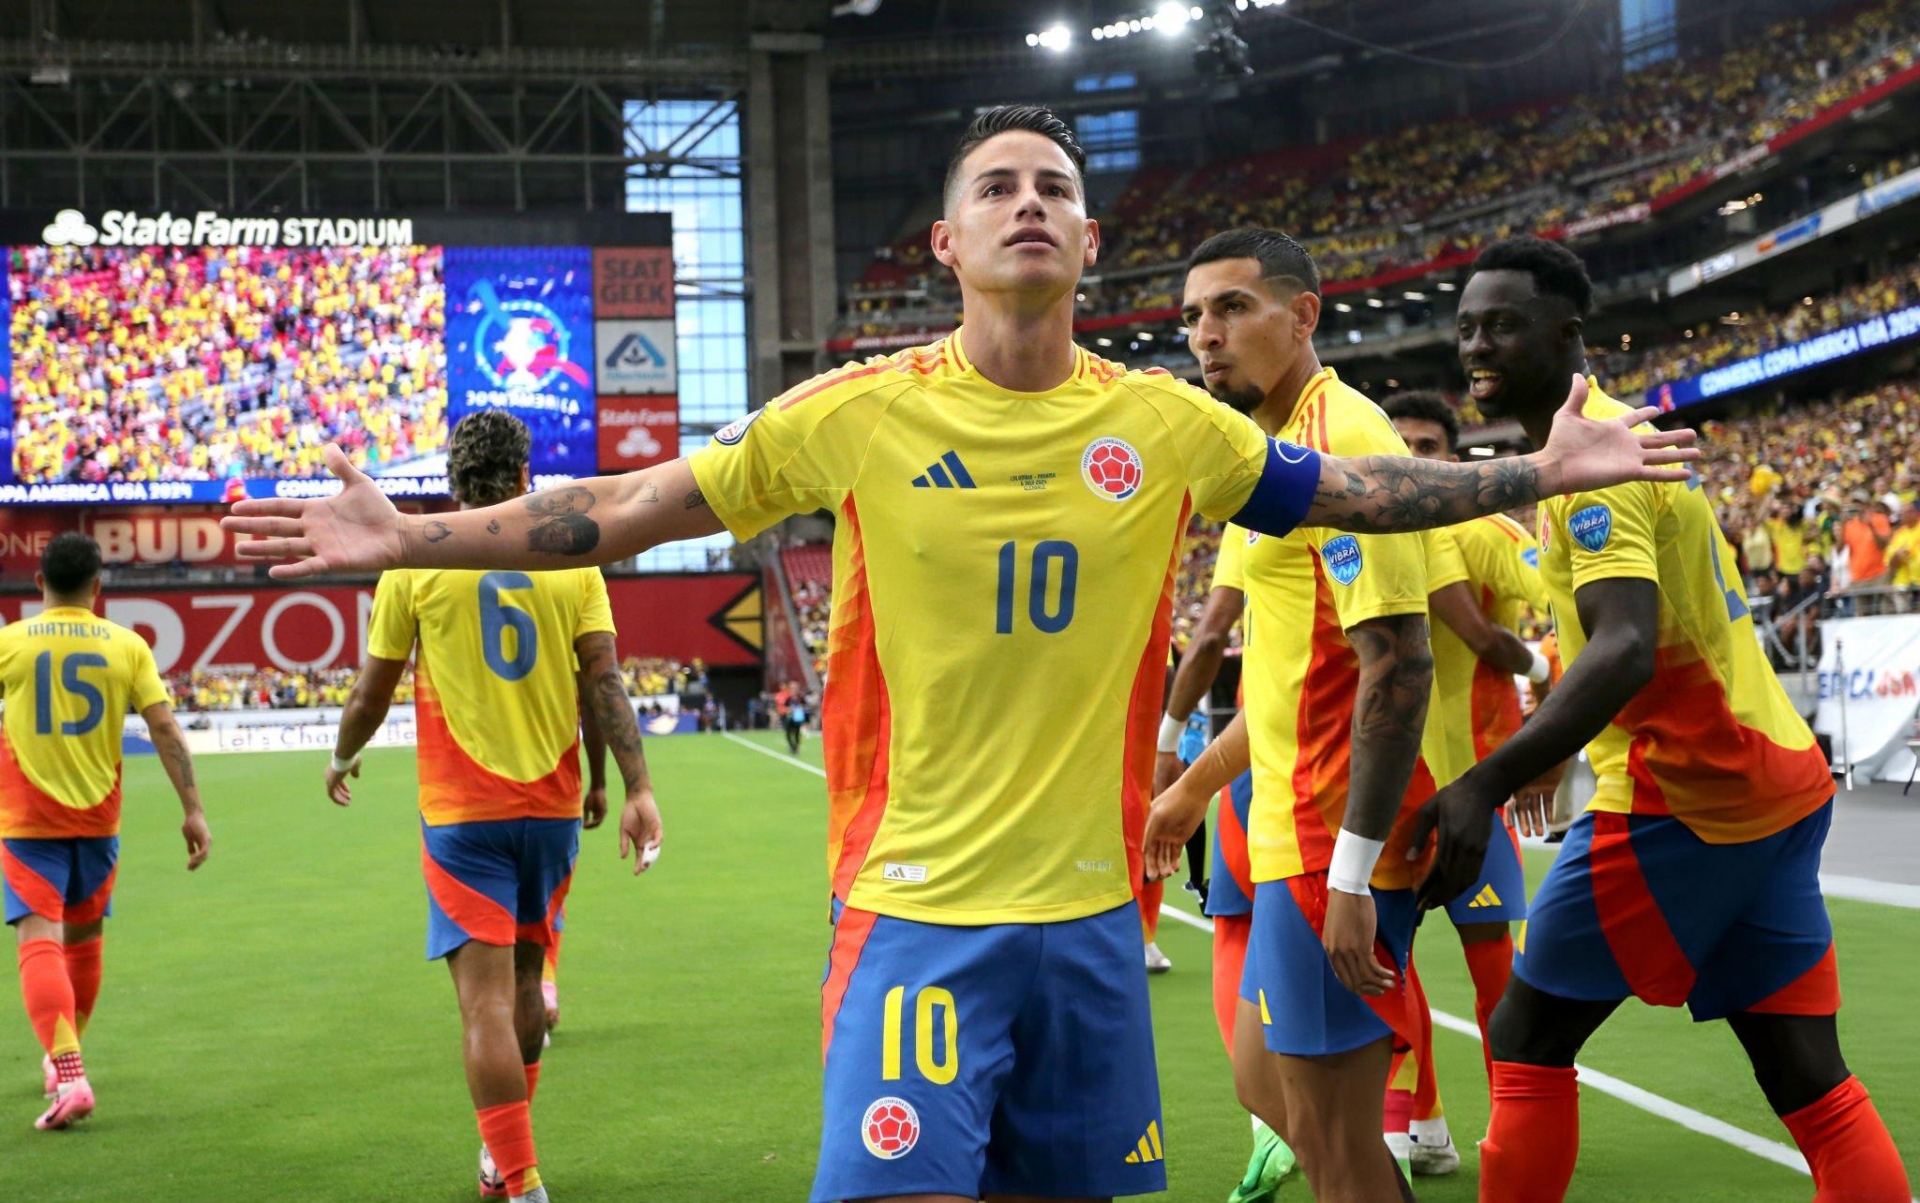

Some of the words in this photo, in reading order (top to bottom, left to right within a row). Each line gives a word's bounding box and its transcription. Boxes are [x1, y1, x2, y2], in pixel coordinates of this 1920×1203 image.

[282, 217, 413, 246] STADIUM
[604, 258, 662, 279] SEAT
[602, 284, 665, 304] GEEK
[28, 483, 110, 502] AMERICA
[112, 483, 148, 500] USA
[148, 482, 193, 500] 2024
[1574, 515, 1606, 532] VIBRA
[94, 518, 225, 563] BUD
[1331, 546, 1356, 564] VIBRA
[996, 540, 1078, 633] 10
[28, 622, 110, 639] MATHEUS
[478, 570, 537, 681] 6
[35, 650, 108, 735] 15
[882, 985, 958, 1085] 10
